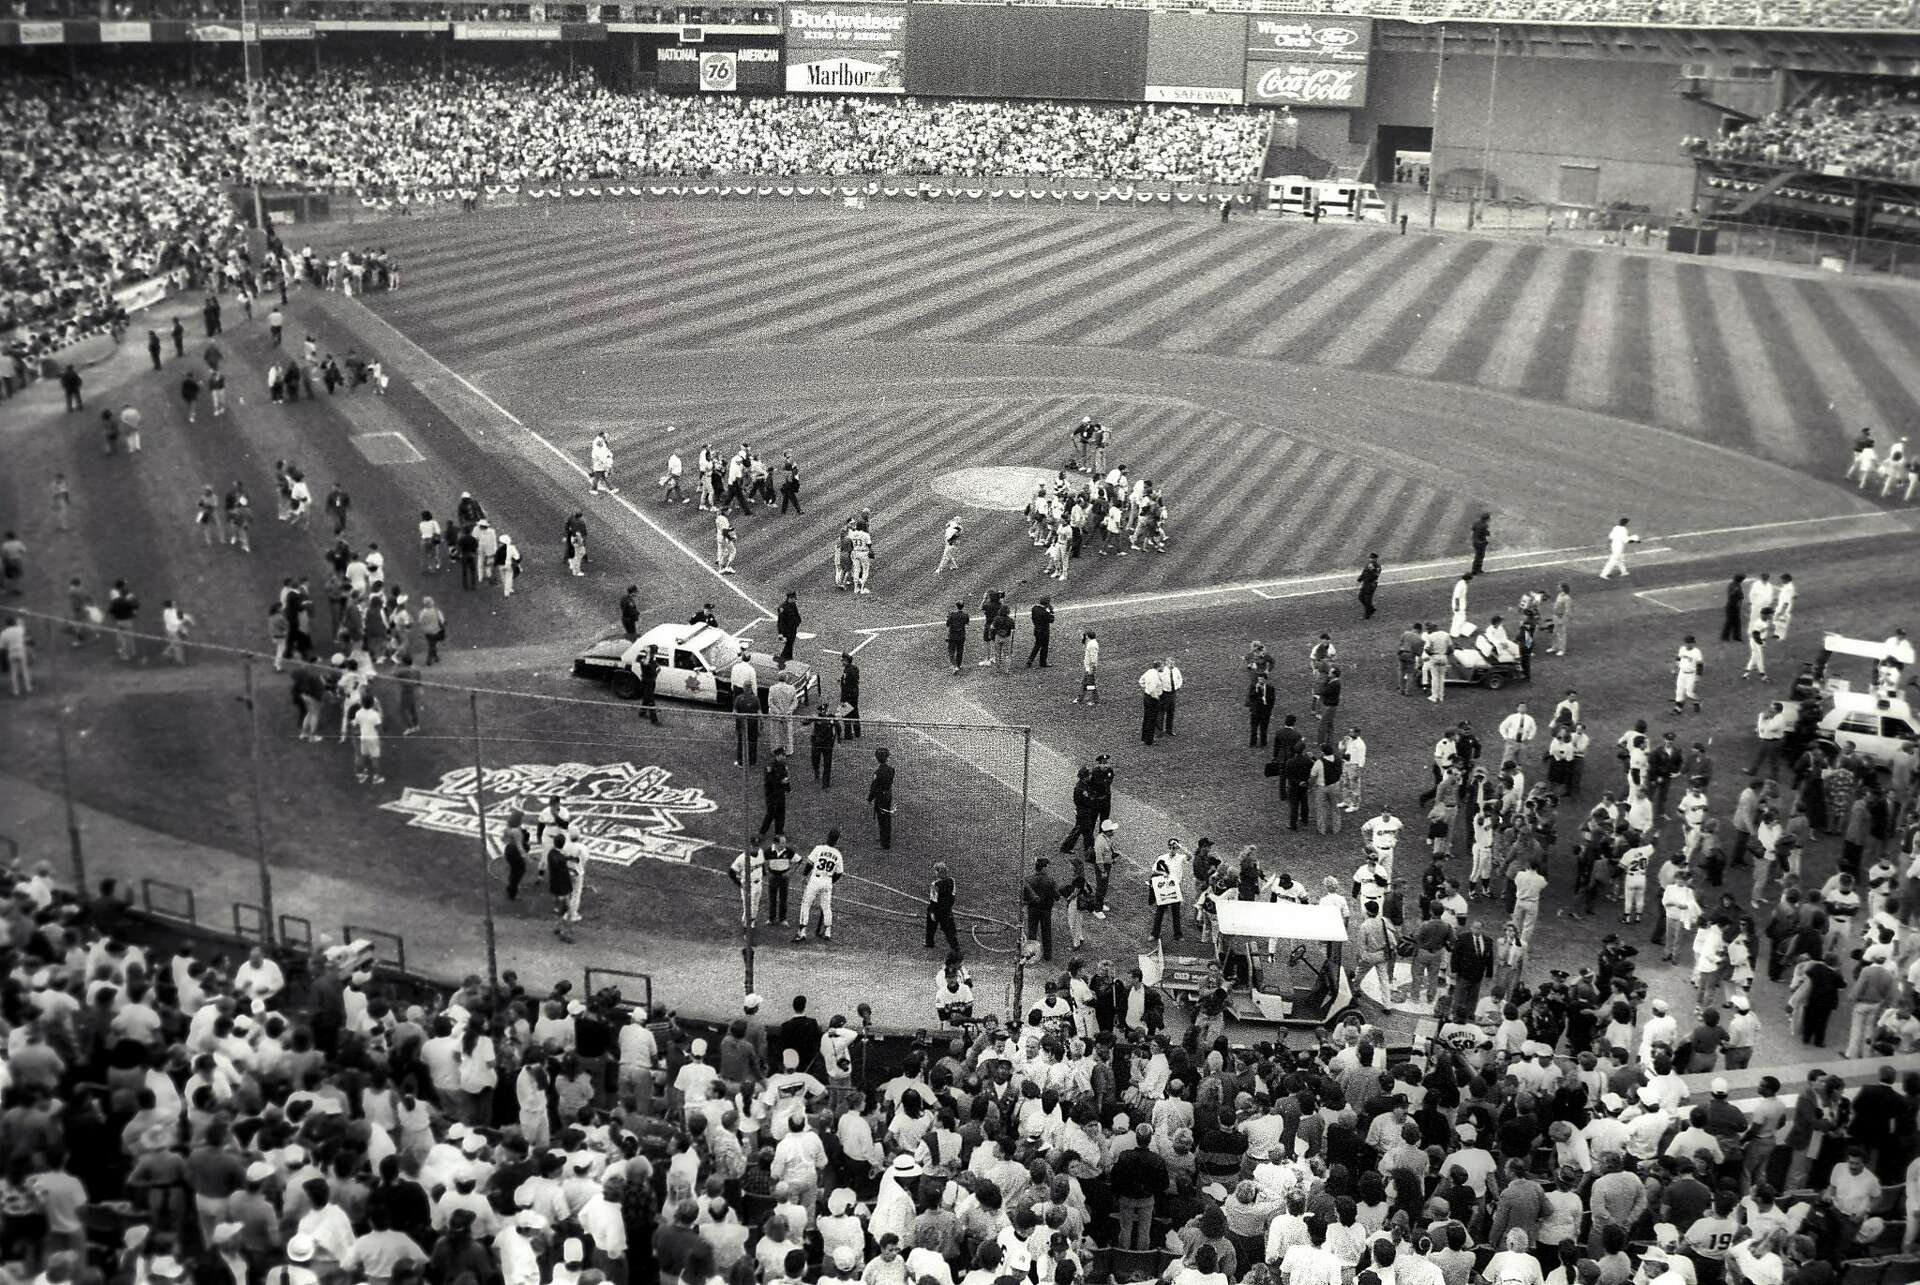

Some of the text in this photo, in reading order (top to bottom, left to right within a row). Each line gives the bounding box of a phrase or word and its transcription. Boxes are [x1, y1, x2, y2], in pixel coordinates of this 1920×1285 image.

[790, 9, 904, 29] Budweiser
[657, 48, 699, 61] NATIONAL
[737, 48, 779, 62] AMERICAN
[709, 61, 729, 79] 76
[1257, 66, 1358, 101] Coca-Cola
[1174, 90, 1230, 99] SAFEWAY
[438, 766, 708, 805] World Series
[1709, 1233, 1732, 1250] 19
